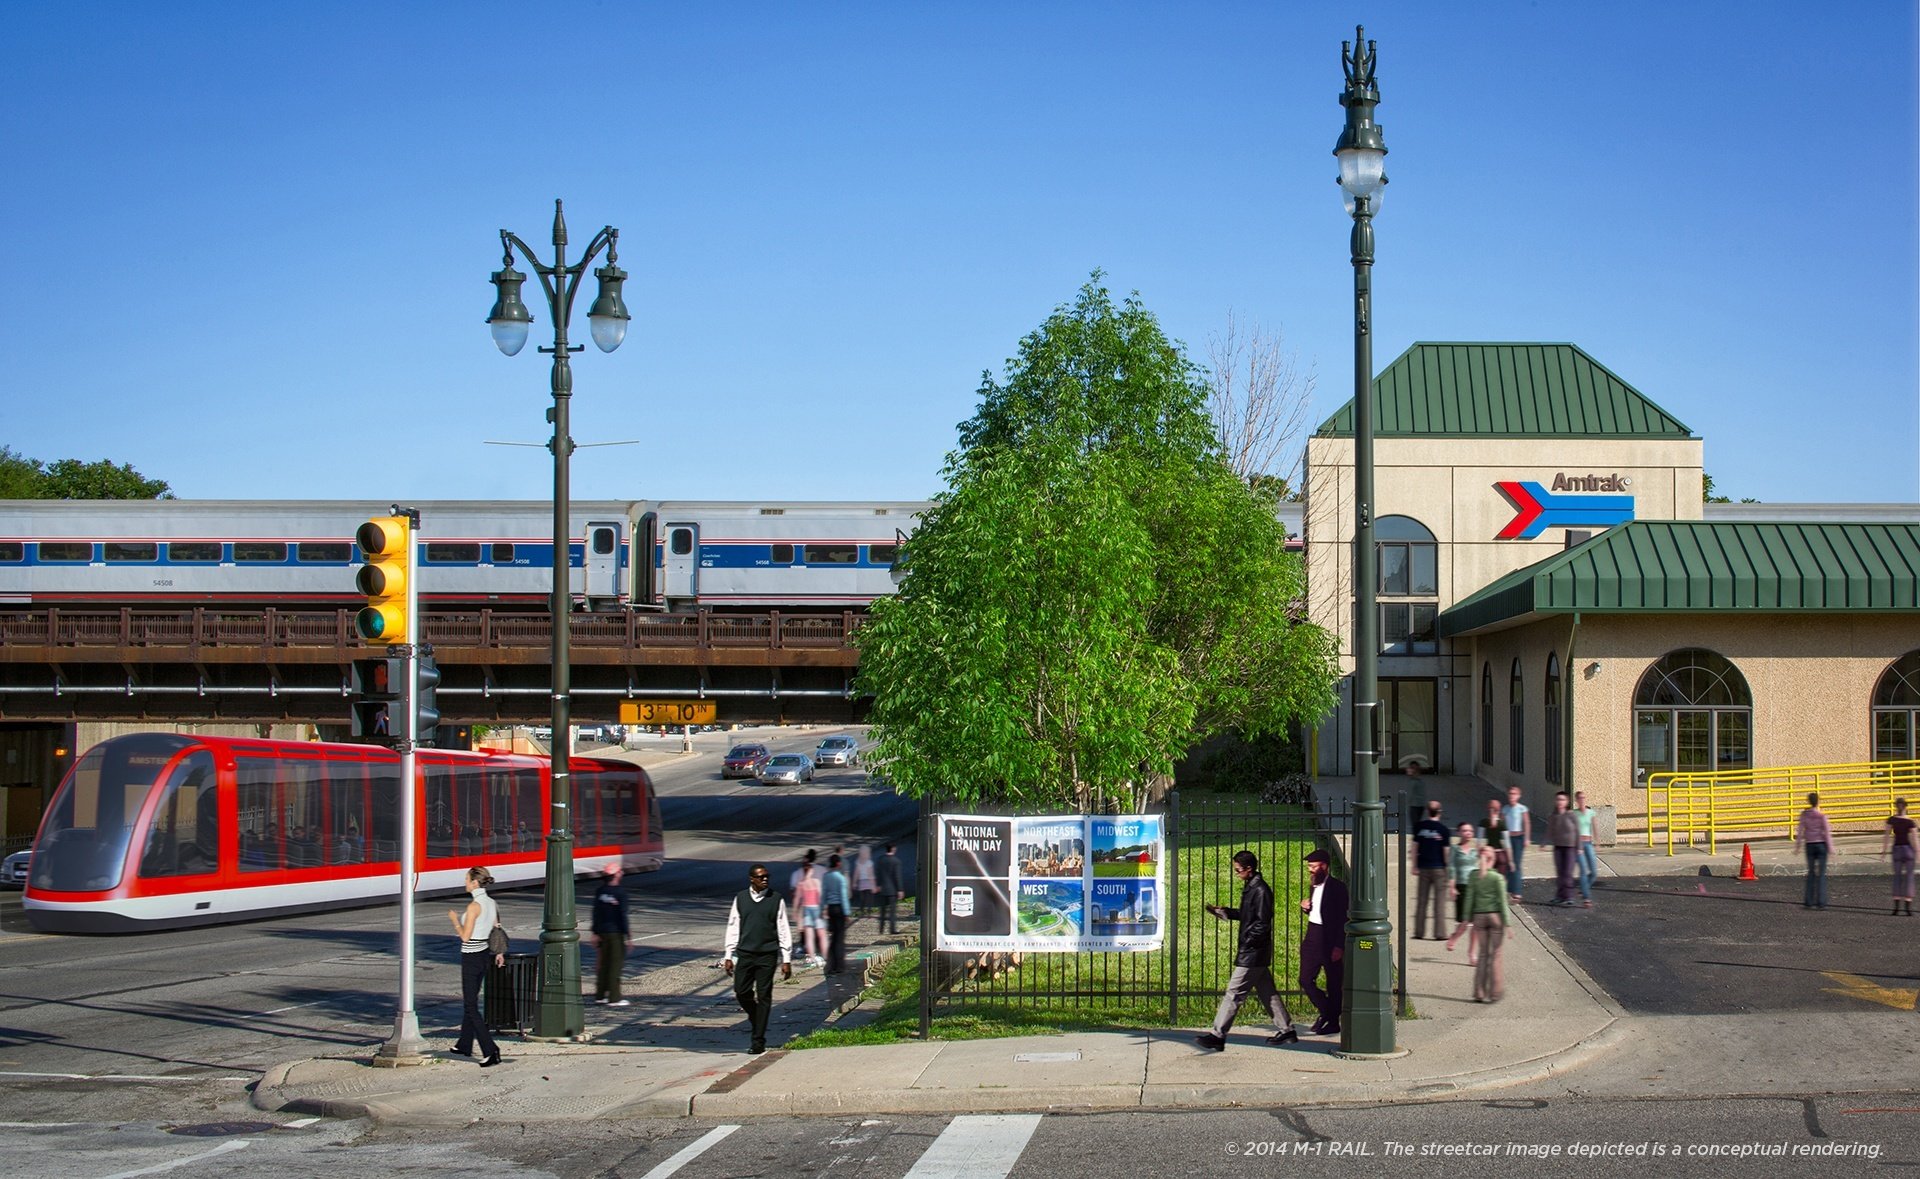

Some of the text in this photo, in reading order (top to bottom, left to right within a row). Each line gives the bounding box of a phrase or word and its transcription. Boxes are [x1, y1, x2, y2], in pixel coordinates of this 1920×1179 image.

[1551, 472, 1626, 492] Amtrak
[152, 579, 174, 587] 54508
[636, 703, 707, 721] 13 FT 10 IN
[950, 825, 999, 838] NATIONAL
[1023, 825, 1076, 837] NORTHEAST
[1097, 825, 1140, 837] MIDWEST
[950, 839, 1002, 852] TRAIN DAY
[1023, 884, 1049, 895] WEST
[1096, 884, 1127, 895] SOUTH
